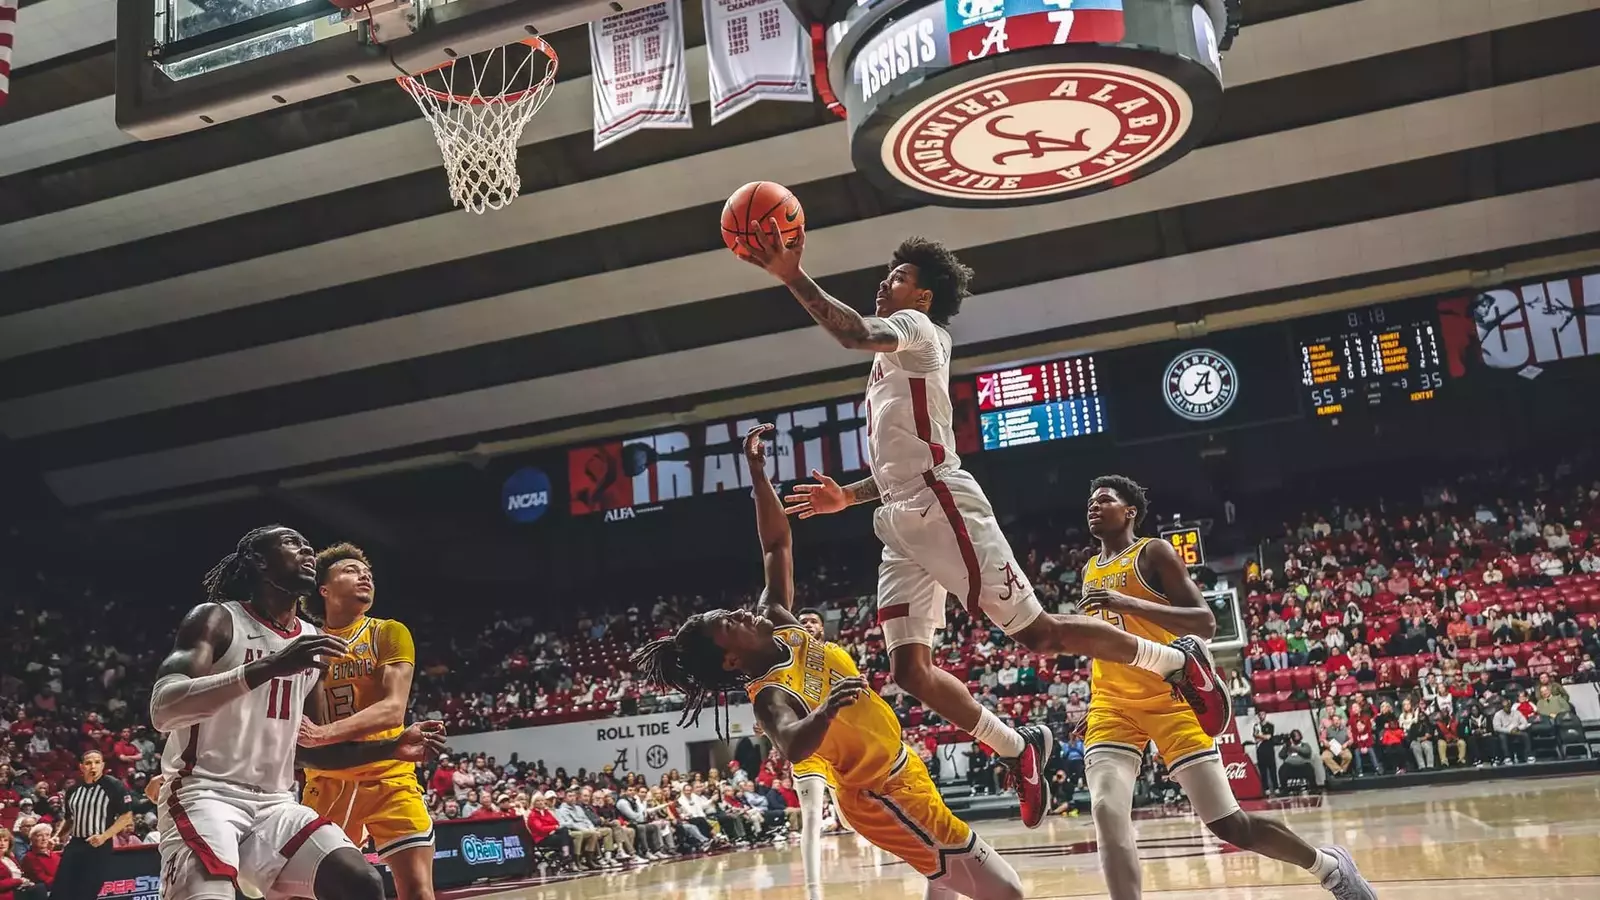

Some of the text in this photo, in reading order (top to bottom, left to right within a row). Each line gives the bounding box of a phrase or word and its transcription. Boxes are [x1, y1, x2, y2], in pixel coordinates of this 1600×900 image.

[612, 25, 660, 41] CHAMPIONS
[760, 31, 781, 40] 2021
[1048, 10, 1075, 44] 7
[861, 18, 936, 103] ASSISTS
[615, 73, 663, 90] CHAMPIONS
[913, 92, 1009, 172] CRIMSON
[1050, 79, 1158, 180] ALABAMA
[940, 168, 1022, 189] TIDE
[1170, 356, 1228, 384] ALABAMA
[1420, 372, 1443, 389] 35
[1312, 388, 1334, 406] 55
[508, 491, 548, 510] NCAA
[604, 506, 636, 522] ALFA
[333, 659, 373, 680] STATE
[266, 678, 292, 720] 11
[597, 722, 670, 741] ROLL TIDE
[462, 836, 503, 863] O'Reilly
[504, 847, 525, 859] PARTS
